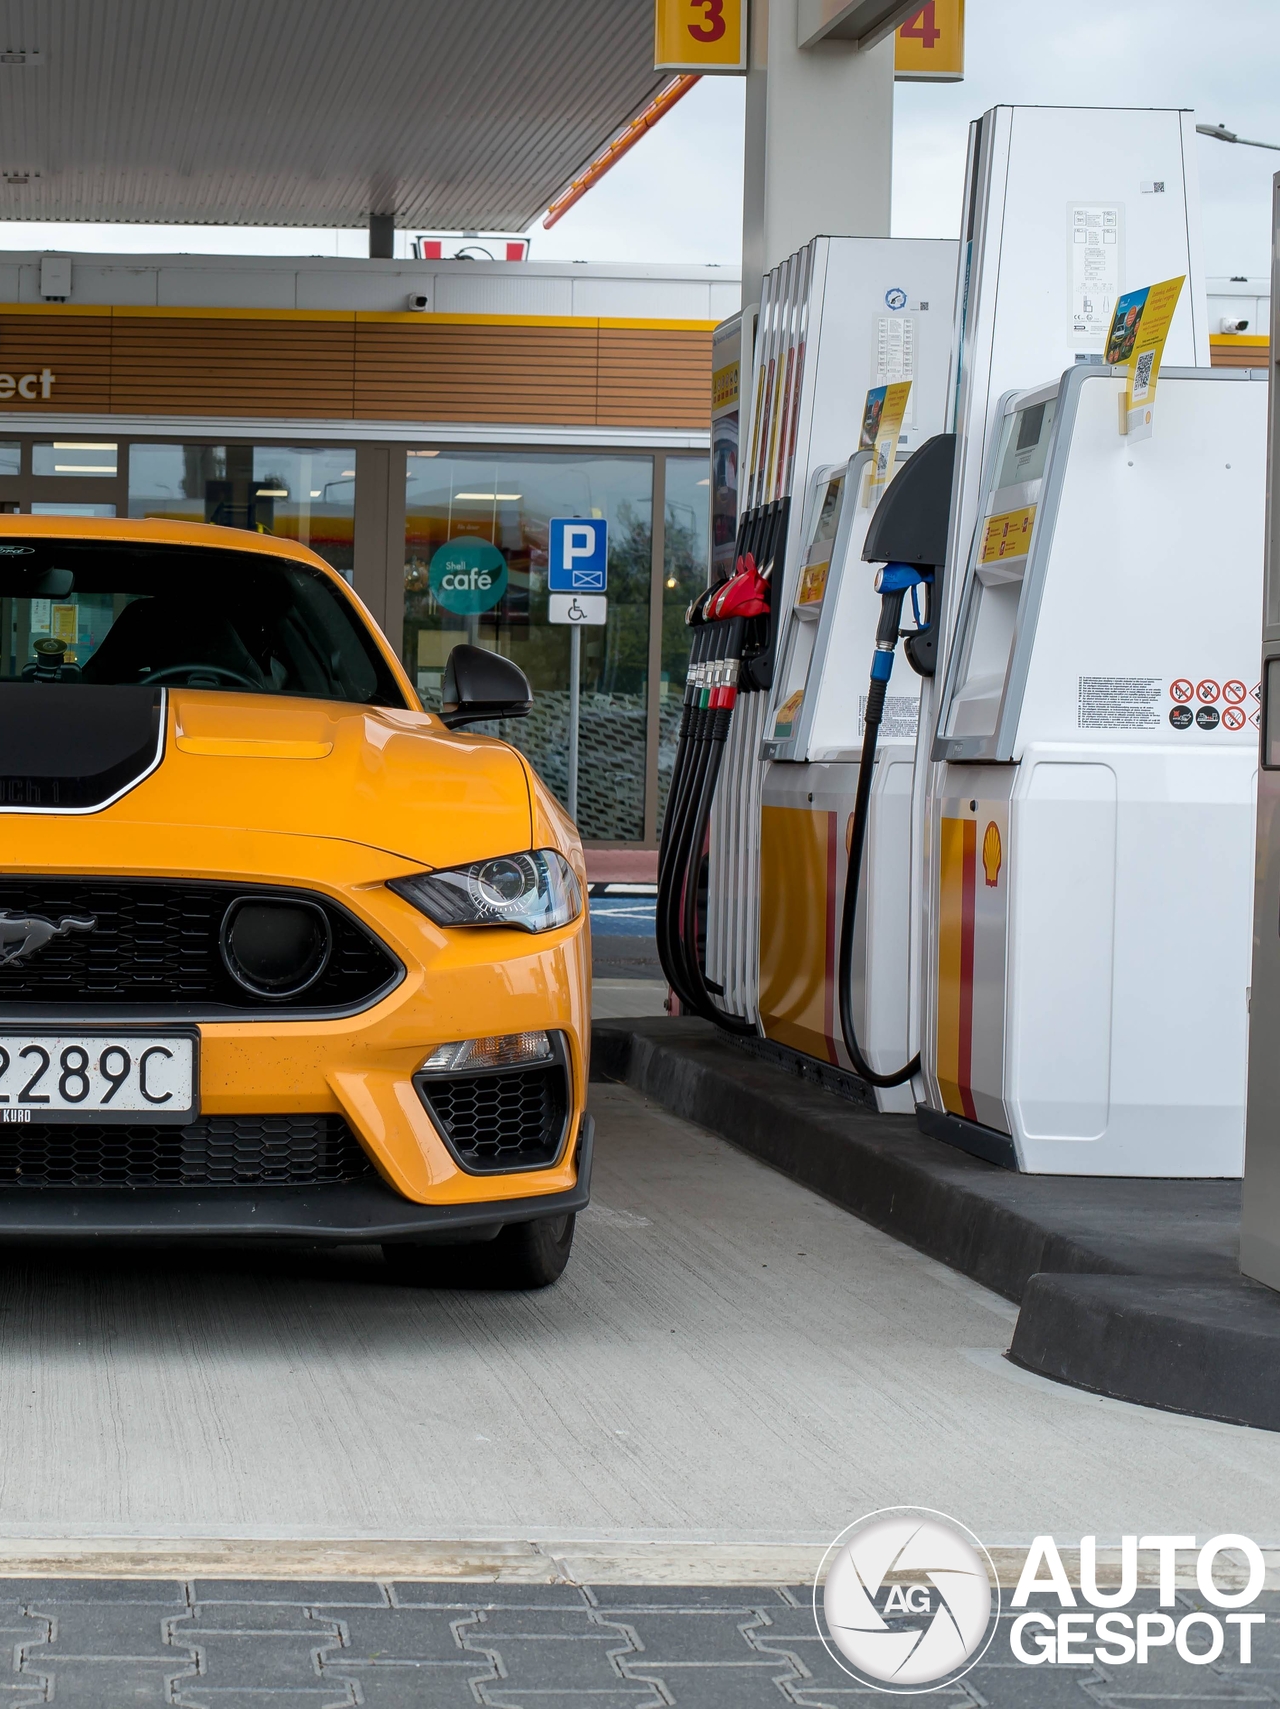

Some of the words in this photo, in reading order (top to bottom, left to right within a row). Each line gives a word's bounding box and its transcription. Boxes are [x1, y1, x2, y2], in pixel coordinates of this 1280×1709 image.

[687, 0, 726, 42] 3
[900, 0, 940, 48] 4
[563, 525, 596, 570] P
[446, 562, 466, 570] Shell
[442, 567, 492, 590] café
[52, 781, 59, 802] 1
[3, 1109, 31, 1122] KURO
